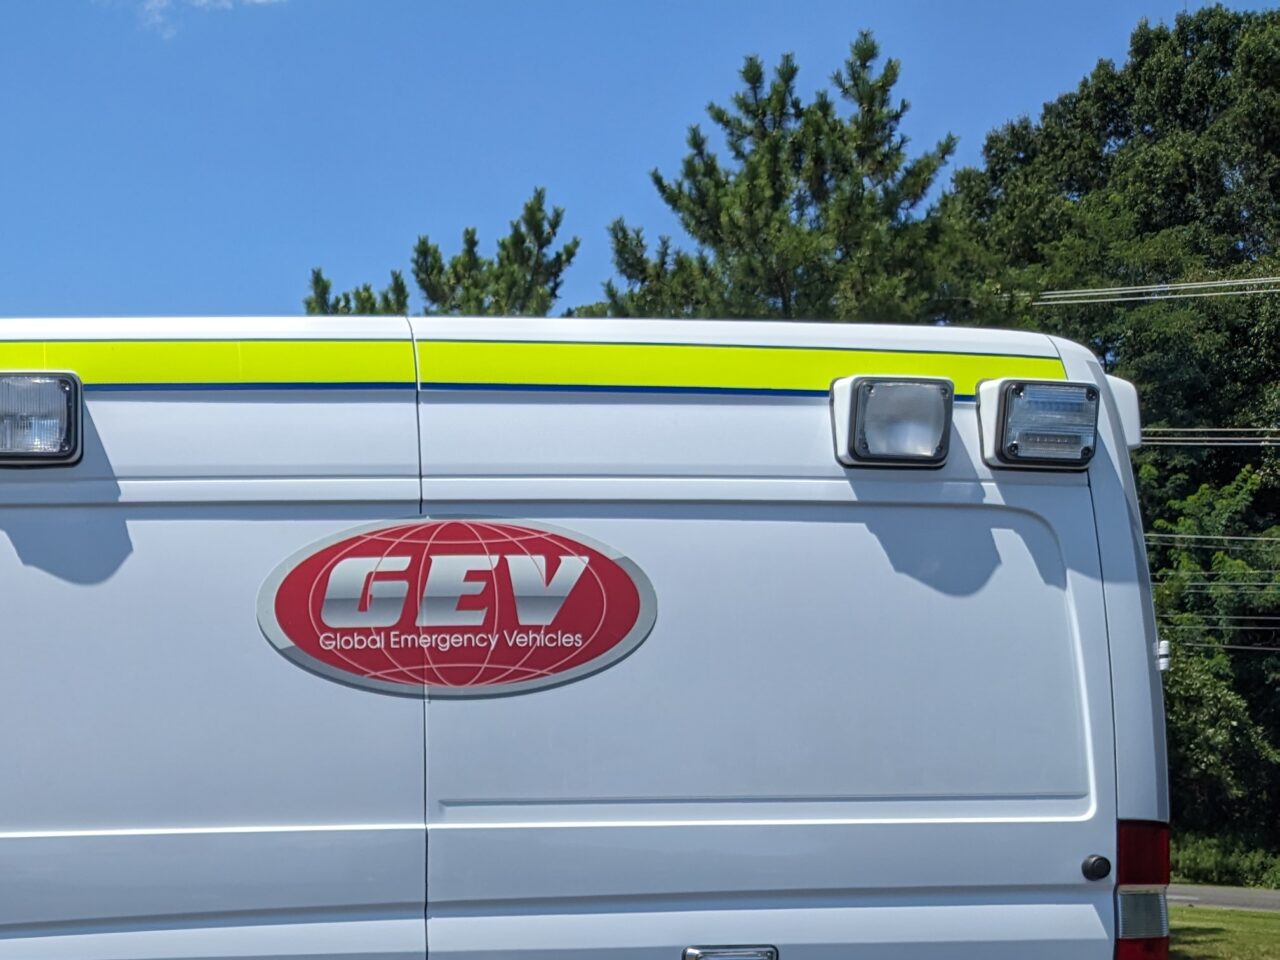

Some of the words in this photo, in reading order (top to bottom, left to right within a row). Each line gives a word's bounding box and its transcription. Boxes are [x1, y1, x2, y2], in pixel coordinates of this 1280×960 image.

[321, 555, 590, 628] GEV
[319, 631, 385, 650] Global
[390, 631, 499, 652] Emergency
[503, 630, 583, 648] Vehicles
